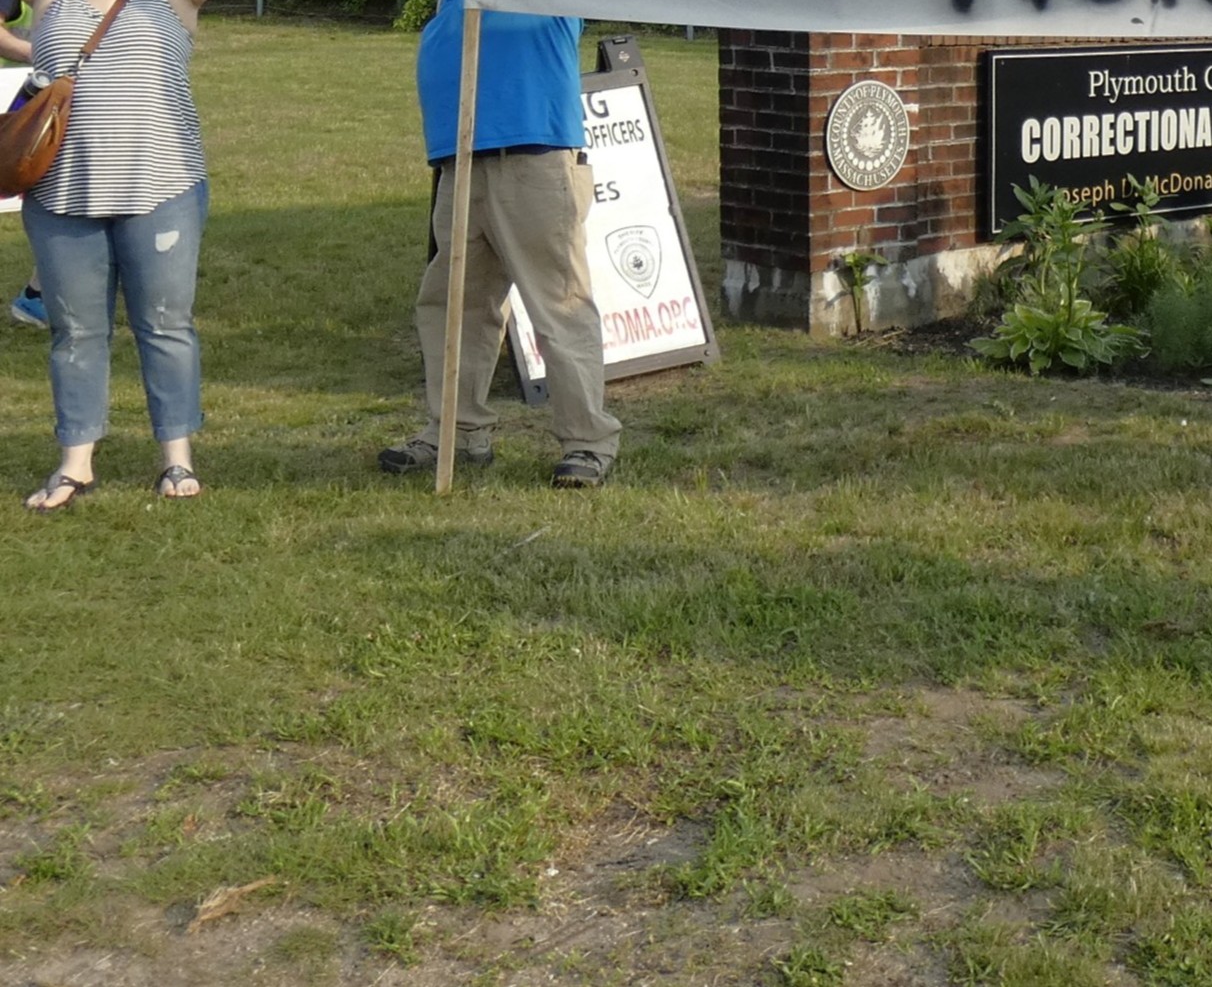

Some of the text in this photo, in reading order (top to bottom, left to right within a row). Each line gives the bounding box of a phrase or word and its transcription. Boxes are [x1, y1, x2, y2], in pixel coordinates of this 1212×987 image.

[1088, 66, 1197, 103] Plymouth
[582, 92, 610, 121] G
[831, 92, 856, 143] COUNTY
[870, 85, 907, 137] PLYMOUTH
[584, 119, 645, 150] OFFICERS
[832, 146, 905, 187] MASSACHUSETTS
